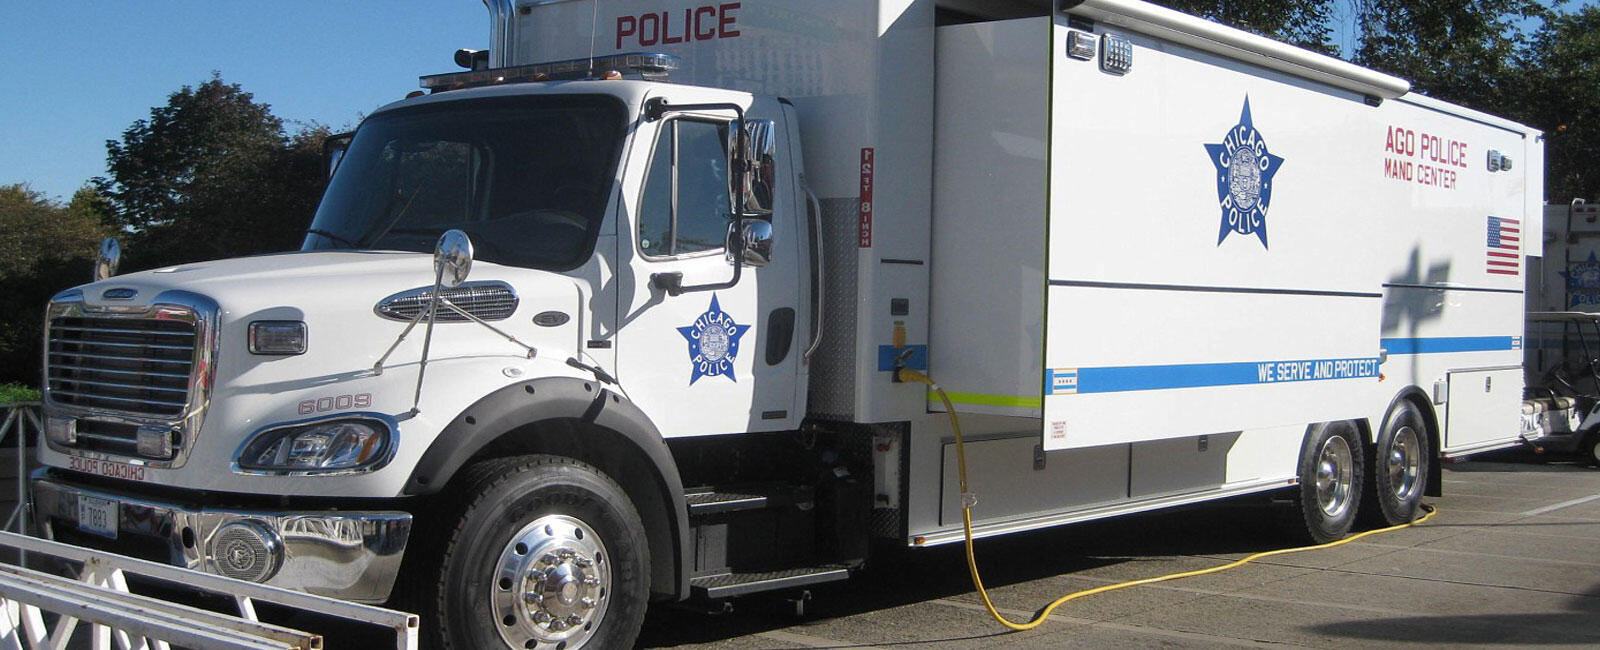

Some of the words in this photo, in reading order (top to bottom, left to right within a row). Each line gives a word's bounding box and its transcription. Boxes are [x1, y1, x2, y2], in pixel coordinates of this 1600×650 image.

[616, 2, 741, 49] POLICE
[1219, 125, 1270, 172] CHICAGO
[1385, 125, 1414, 156] AGO
[1421, 133, 1467, 168] POLICE
[1385, 157, 1413, 182] MAND
[1417, 164, 1457, 190] CENTER
[1220, 194, 1267, 232] POLICE
[690, 311, 737, 340] CHICAGO
[693, 352, 735, 376] POLICE
[1257, 363, 1275, 382] WE
[1276, 361, 1312, 380] SERVE
[1313, 360, 1334, 378] AND
[1334, 359, 1378, 377] PROTECT
[298, 393, 372, 415] 6009
